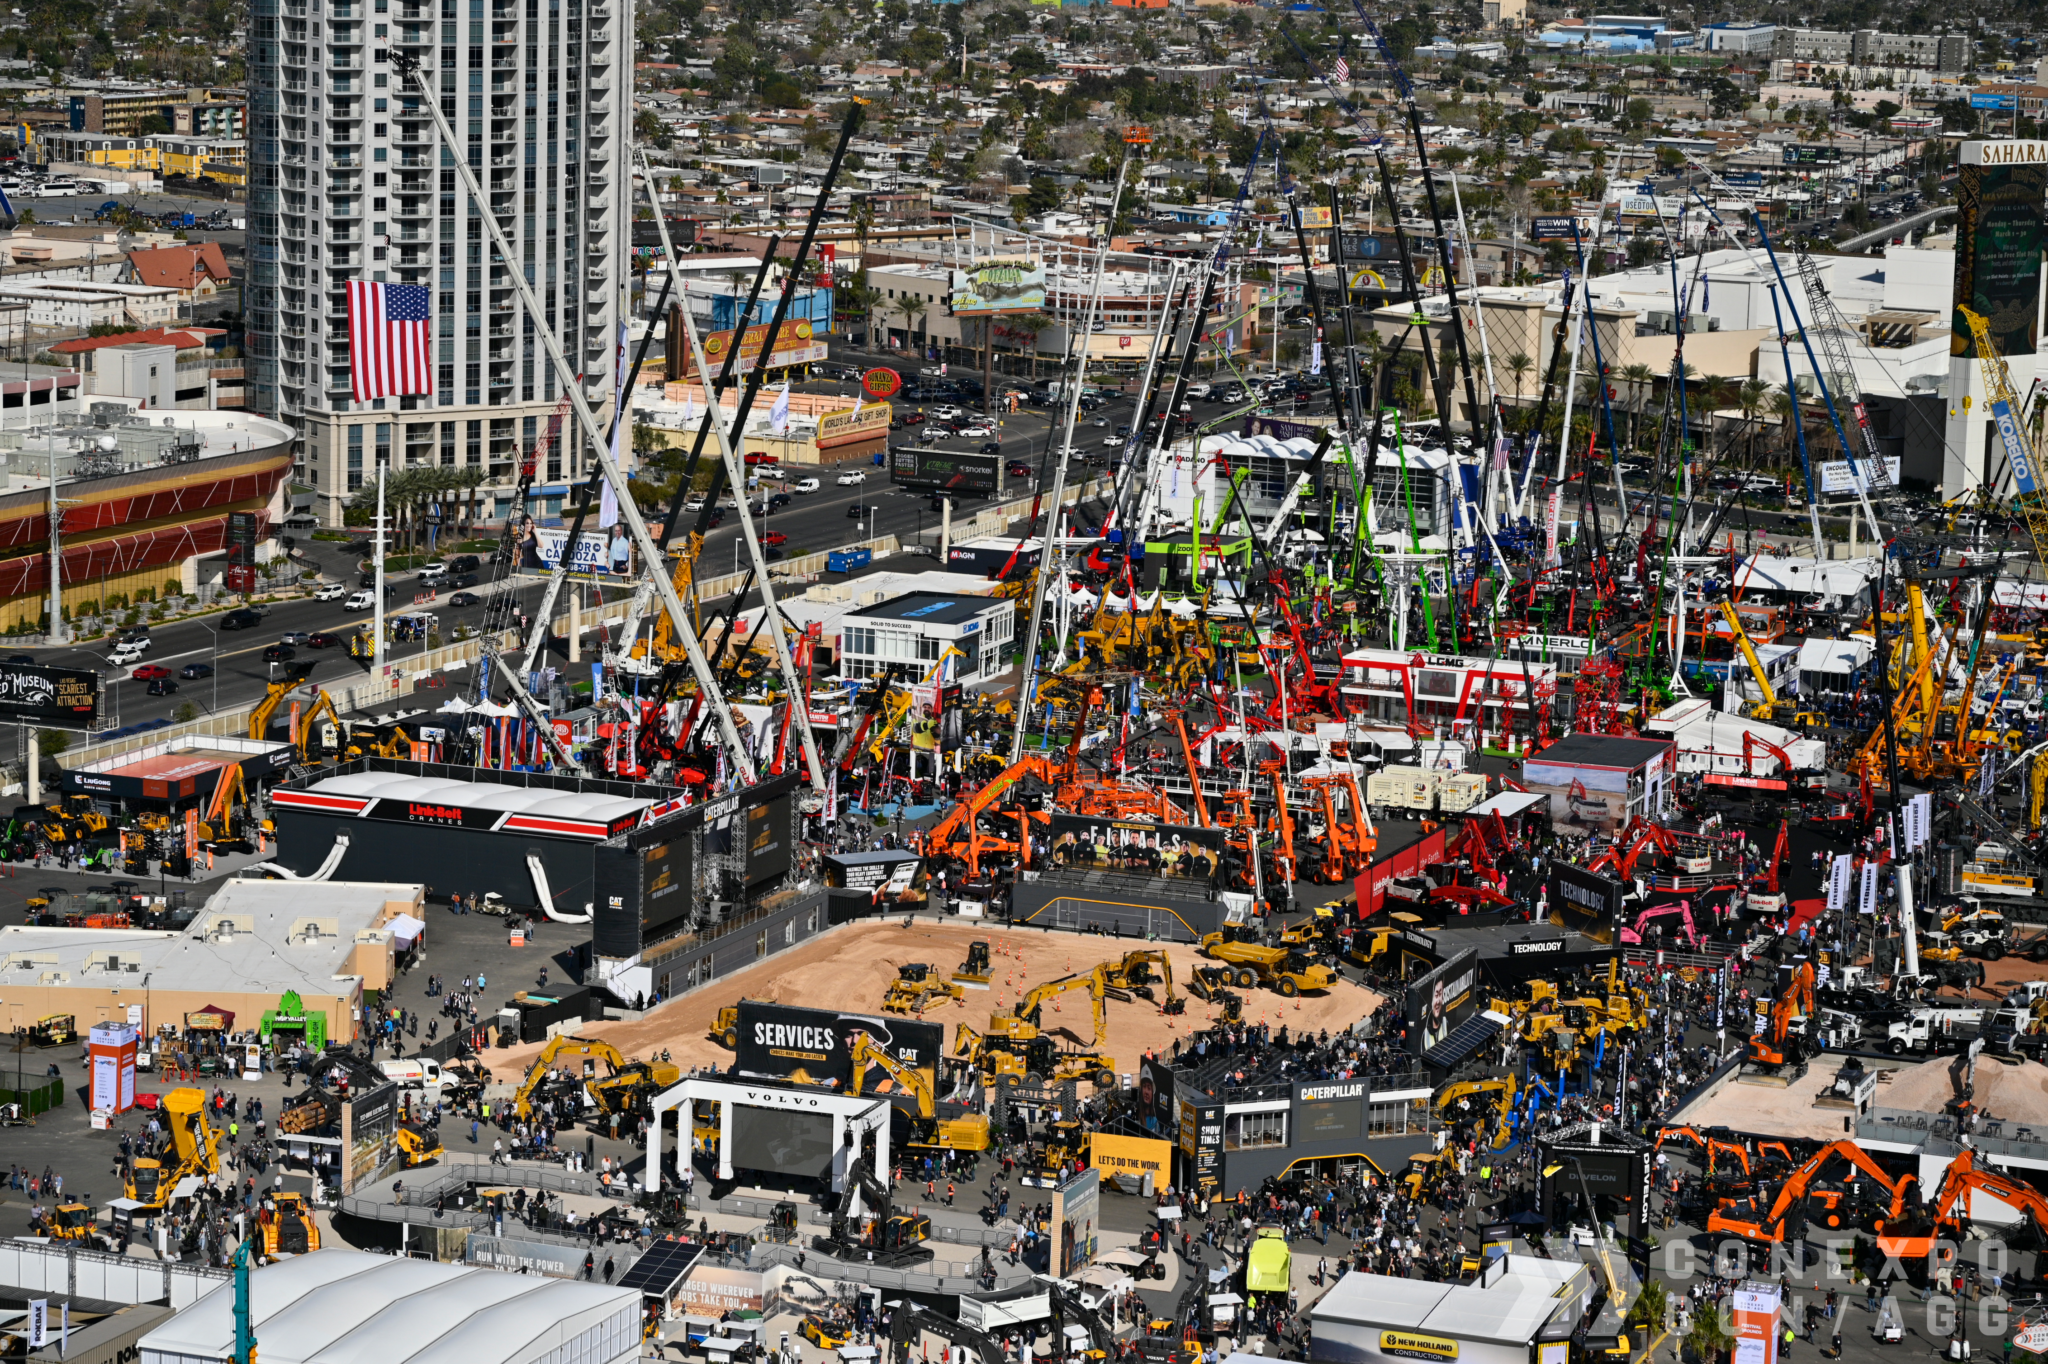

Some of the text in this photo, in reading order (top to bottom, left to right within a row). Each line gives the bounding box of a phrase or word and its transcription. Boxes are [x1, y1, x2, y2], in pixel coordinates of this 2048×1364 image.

[1983, 143, 2047, 163] SAHARA
[868, 371, 894, 384] BONANZA
[869, 381, 891, 392] GIFTS
[1996, 413, 2029, 480] KOBELCO
[965, 465, 993, 474] snorkel
[552, 539, 593, 552] VICOR
[950, 550, 975, 560] MAGNI
[891, 623, 912, 632] SUCCEED
[11, 672, 54, 696] MUSEUM
[409, 803, 462, 820] Link-Belt
[704, 796, 739, 822] CATERPILLAR
[409, 814, 462, 825] CRANES
[609, 896, 624, 907] CAT
[1560, 880, 1605, 911] TECHNOLOGY
[1406, 931, 1433, 950] TECHNOLOGY
[1513, 941, 1562, 953] TECHNOLOGY
[1716, 968, 1724, 1027] DEVELON
[754, 1022, 835, 1051] SERVICES
[899, 1047, 919, 1063] CAT
[747, 1091, 818, 1107] VOLVO
[1160, 1092, 1169, 1106] CAT
[1301, 1084, 1363, 1100] CATERPILLAR
[1201, 1125, 1221, 1135] SHOW
[1201, 1135, 1220, 1144] TIMES
[1098, 1155, 1162, 1172] LET'S DO THE WORK.
[1641, 1152, 1650, 1225] DEVELON
[476, 1250, 564, 1272] RUN WITH THE POWER
[678, 1291, 697, 1303] JOBS
[700, 1293, 720, 1306] TAKE
[710, 1283, 754, 1299] WHEREVER
[1398, 1338, 1453, 1352] NEW HOLLAND
[1394, 1349, 1443, 1361] CONSTRUCTION
